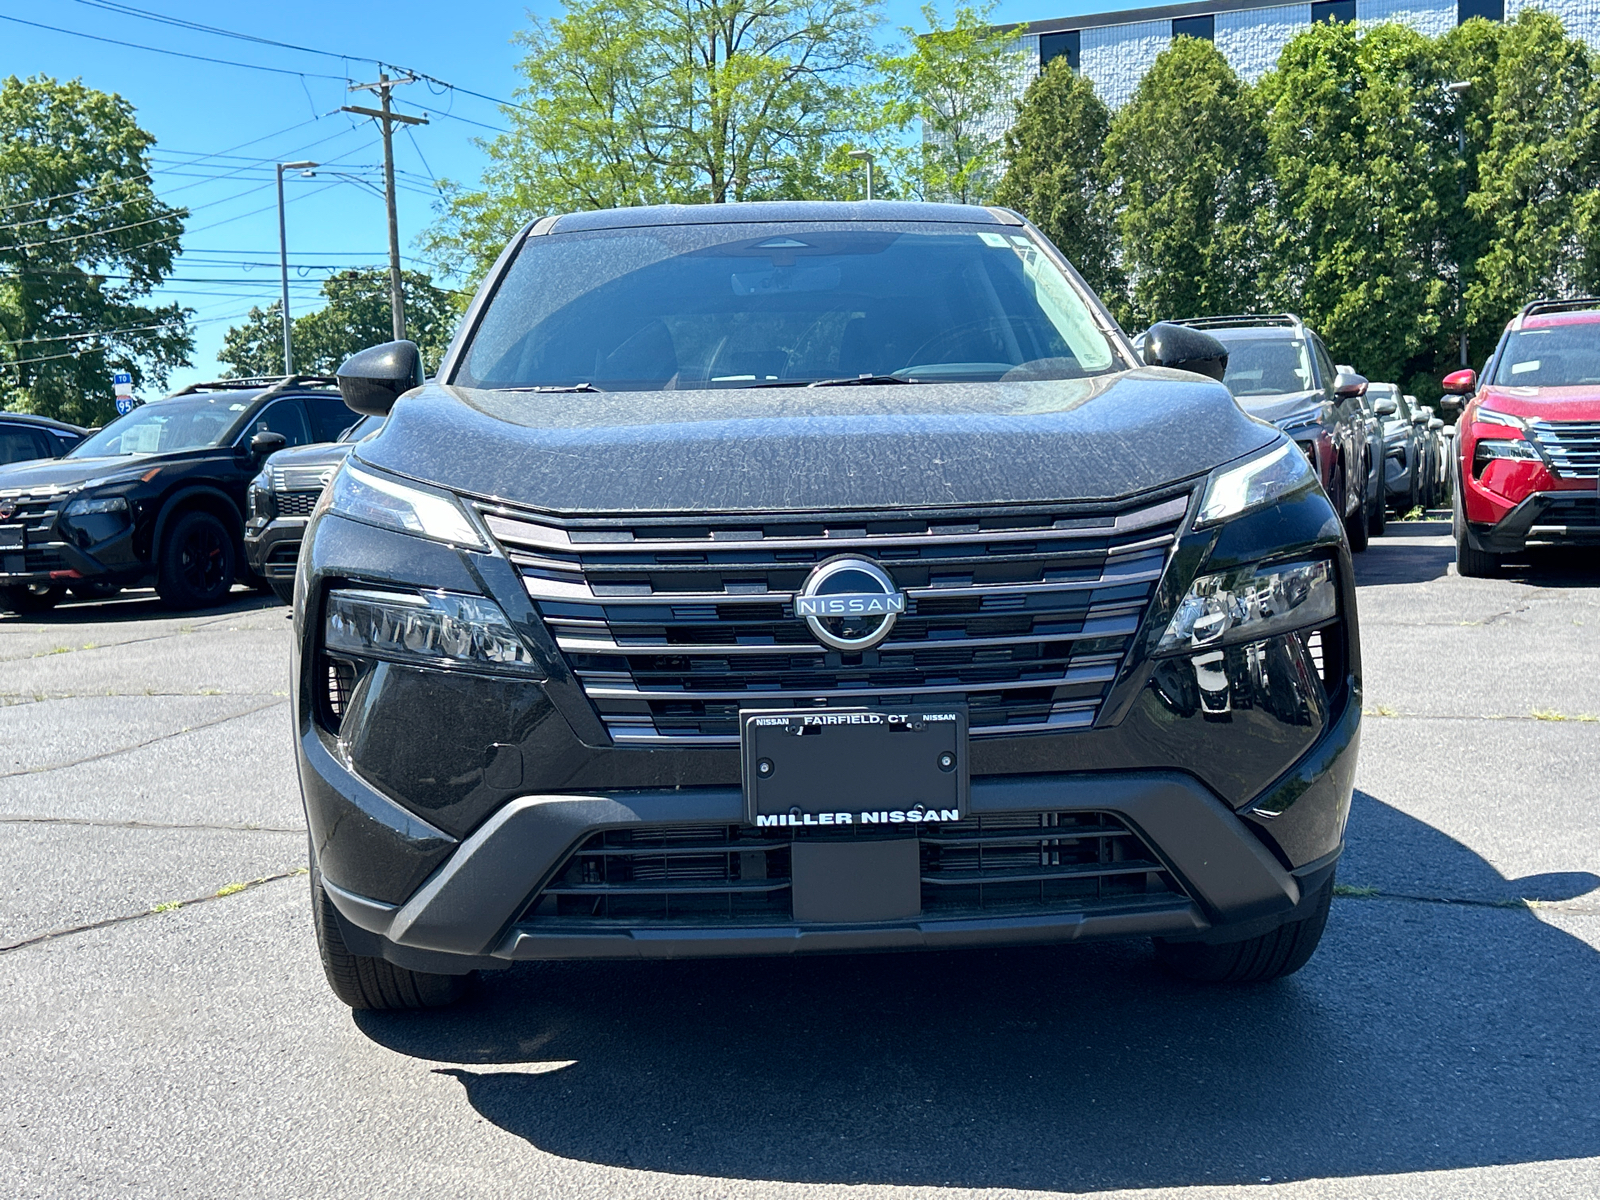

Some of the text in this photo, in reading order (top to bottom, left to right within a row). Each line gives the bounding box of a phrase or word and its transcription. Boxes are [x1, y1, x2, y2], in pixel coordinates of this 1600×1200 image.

[119, 402, 130, 412] 95
[800, 597, 902, 613] NISSAN
[756, 718, 789, 726] NISSAN
[804, 714, 909, 726] FAIRFIELD, CT
[923, 713, 956, 721] NISSAN
[757, 809, 959, 827] MILLER NISSAN
